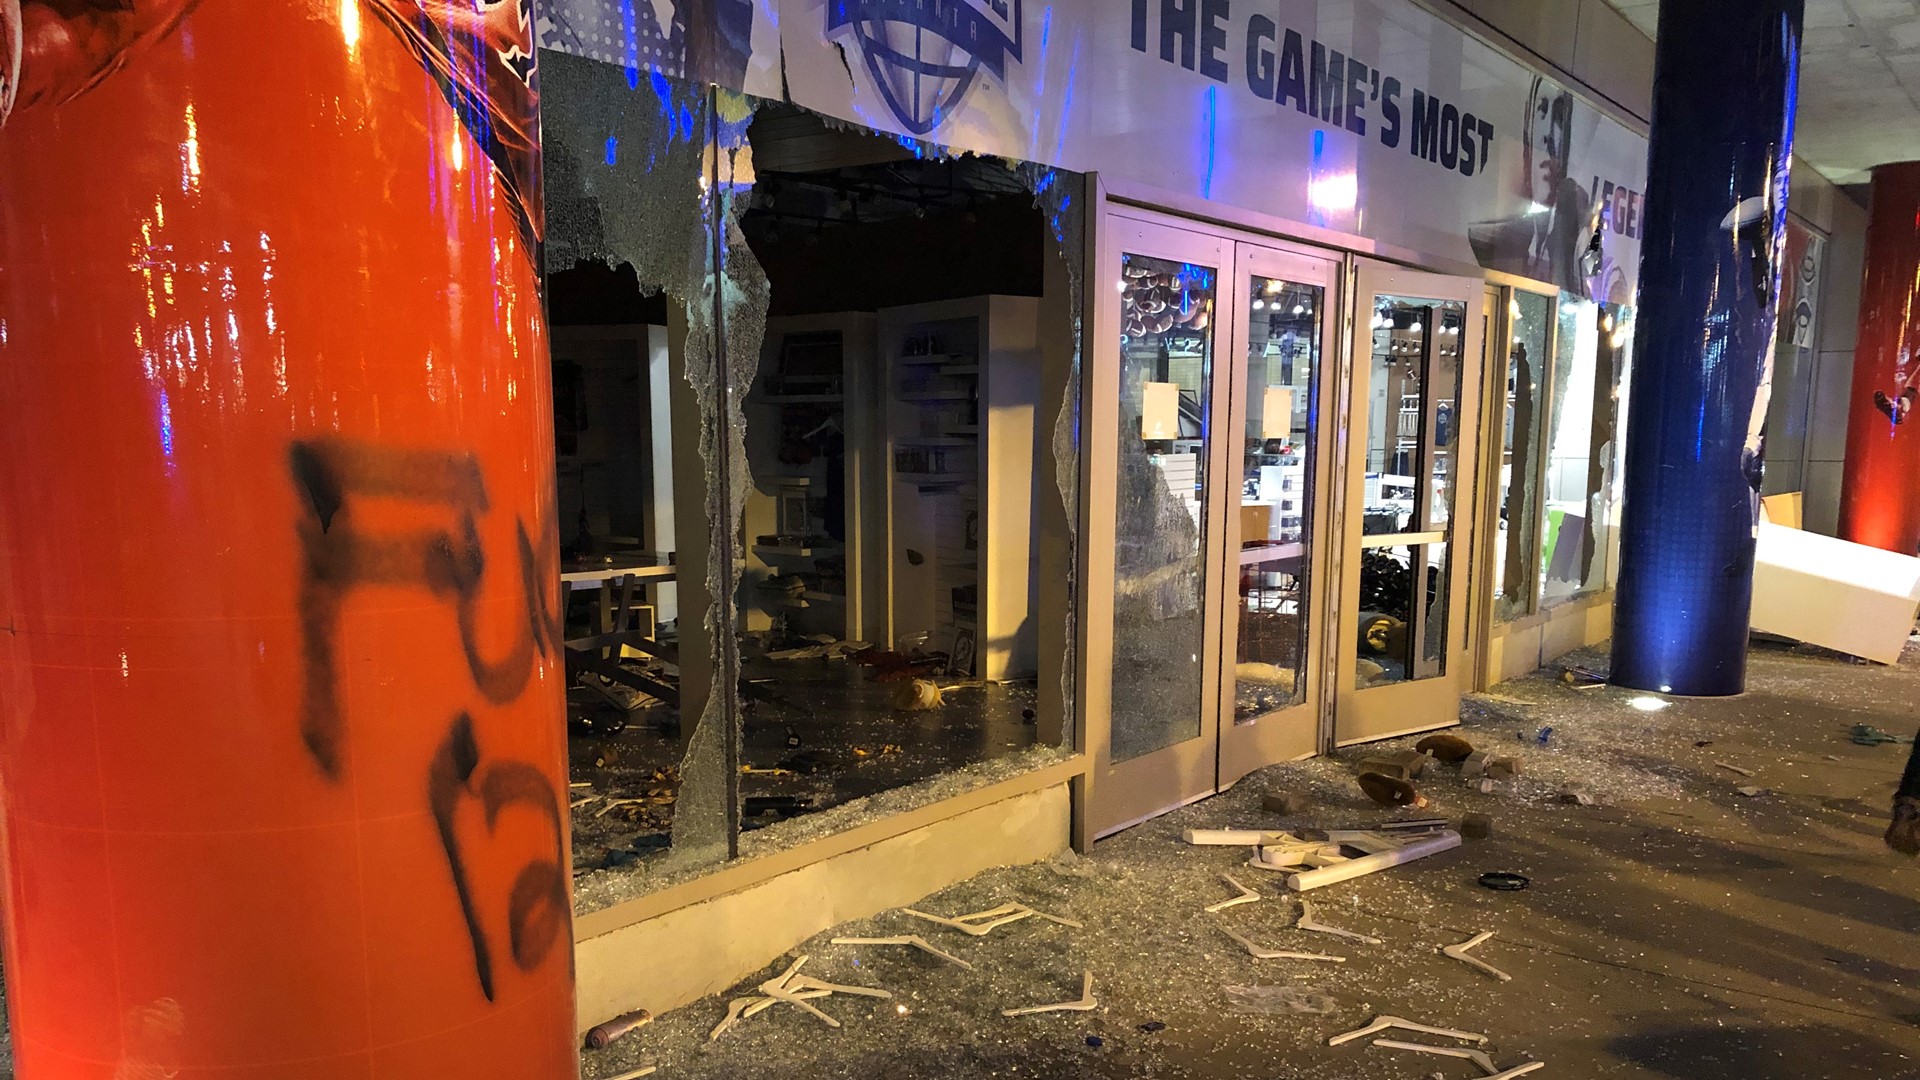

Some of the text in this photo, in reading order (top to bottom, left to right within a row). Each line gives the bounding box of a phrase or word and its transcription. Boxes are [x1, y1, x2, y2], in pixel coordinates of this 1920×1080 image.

[861, 0, 977, 41] ANTA
[1246, 13, 1401, 148] GAME'S
[1410, 88, 1494, 177] MOST
